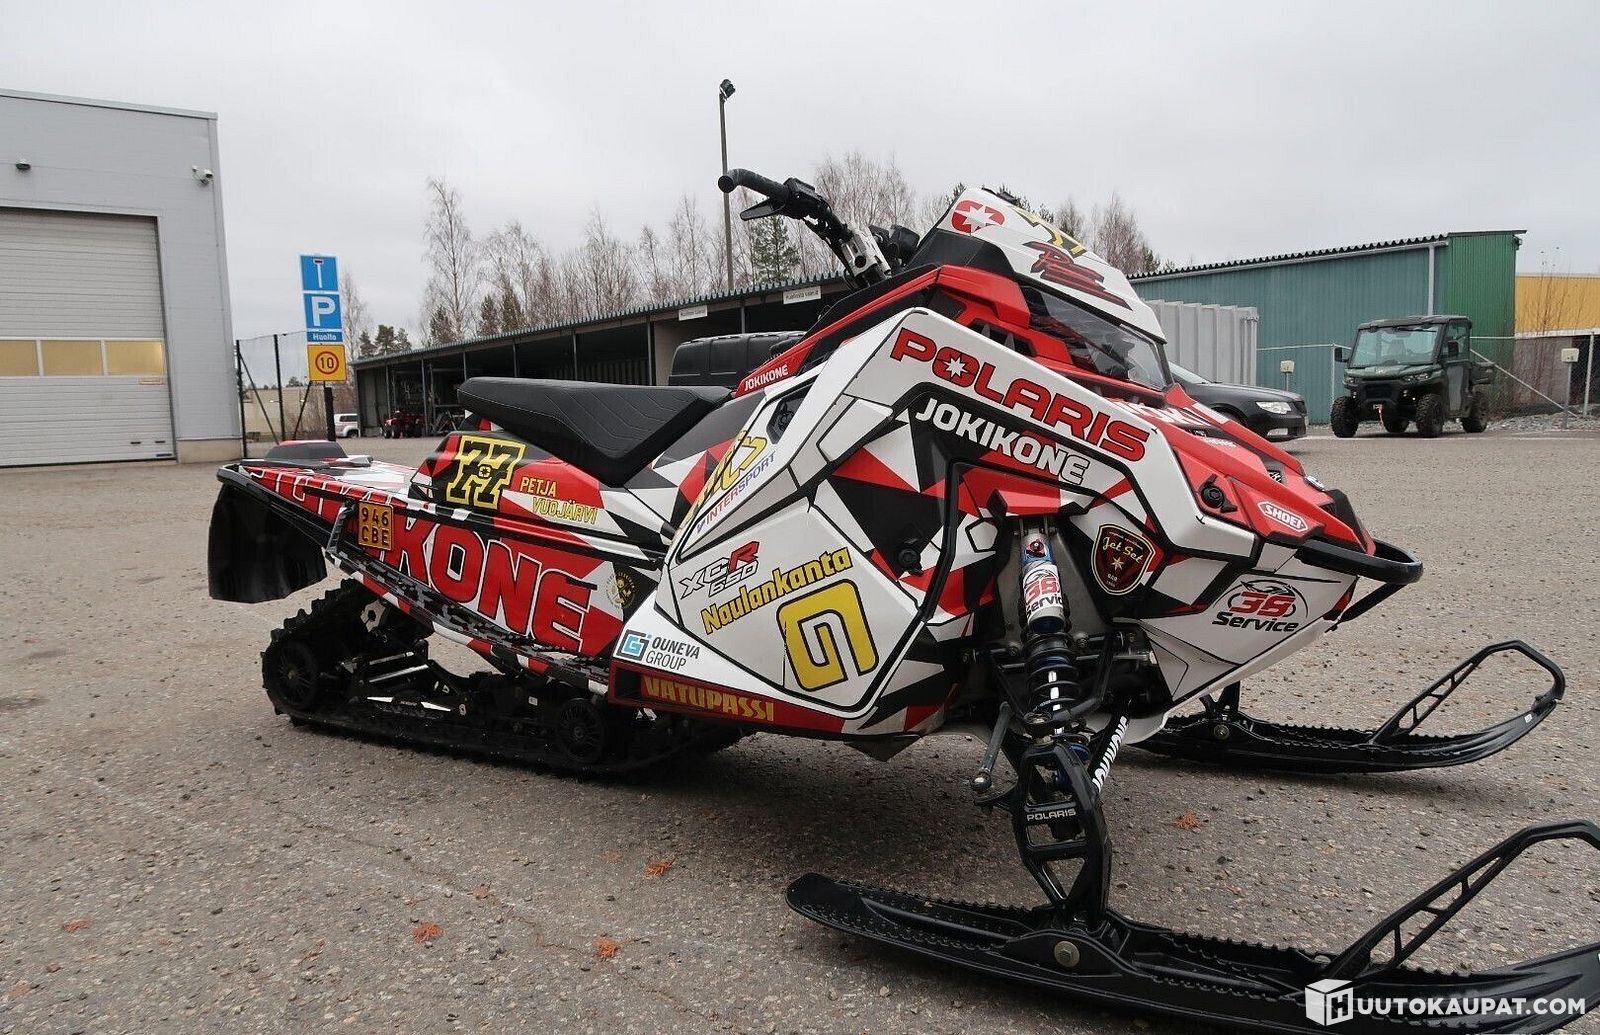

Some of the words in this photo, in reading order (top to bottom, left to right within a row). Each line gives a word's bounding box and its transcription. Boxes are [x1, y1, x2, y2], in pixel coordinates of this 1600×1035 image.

[311, 296, 336, 326] P
[312, 332, 337, 341] Huolto
[320, 357, 335, 369] 10
[744, 363, 789, 392] JOKIKONE
[890, 327, 1150, 462] POLARIS
[915, 397, 1091, 486] JOKIKONE
[519, 476, 558, 498] PETJA
[706, 451, 775, 525] INTERSPORT
[361, 507, 390, 526] 946
[532, 496, 598, 525] VUOJÄRVI
[1265, 503, 1304, 530] SHOEI
[361, 527, 389, 550] CBE
[1102, 536, 1121, 551] Jet
[1122, 546, 1144, 564] Set
[679, 541, 760, 600] XCR
[708, 560, 759, 598] 650
[700, 547, 854, 635] Naulankanta
[1212, 611, 1299, 632] Service
[645, 650, 687, 671] GROUP
[651, 636, 701, 660] OUNEVA
[644, 676, 774, 722] VATUPASSI
[1026, 808, 1077, 821] POLARIS
